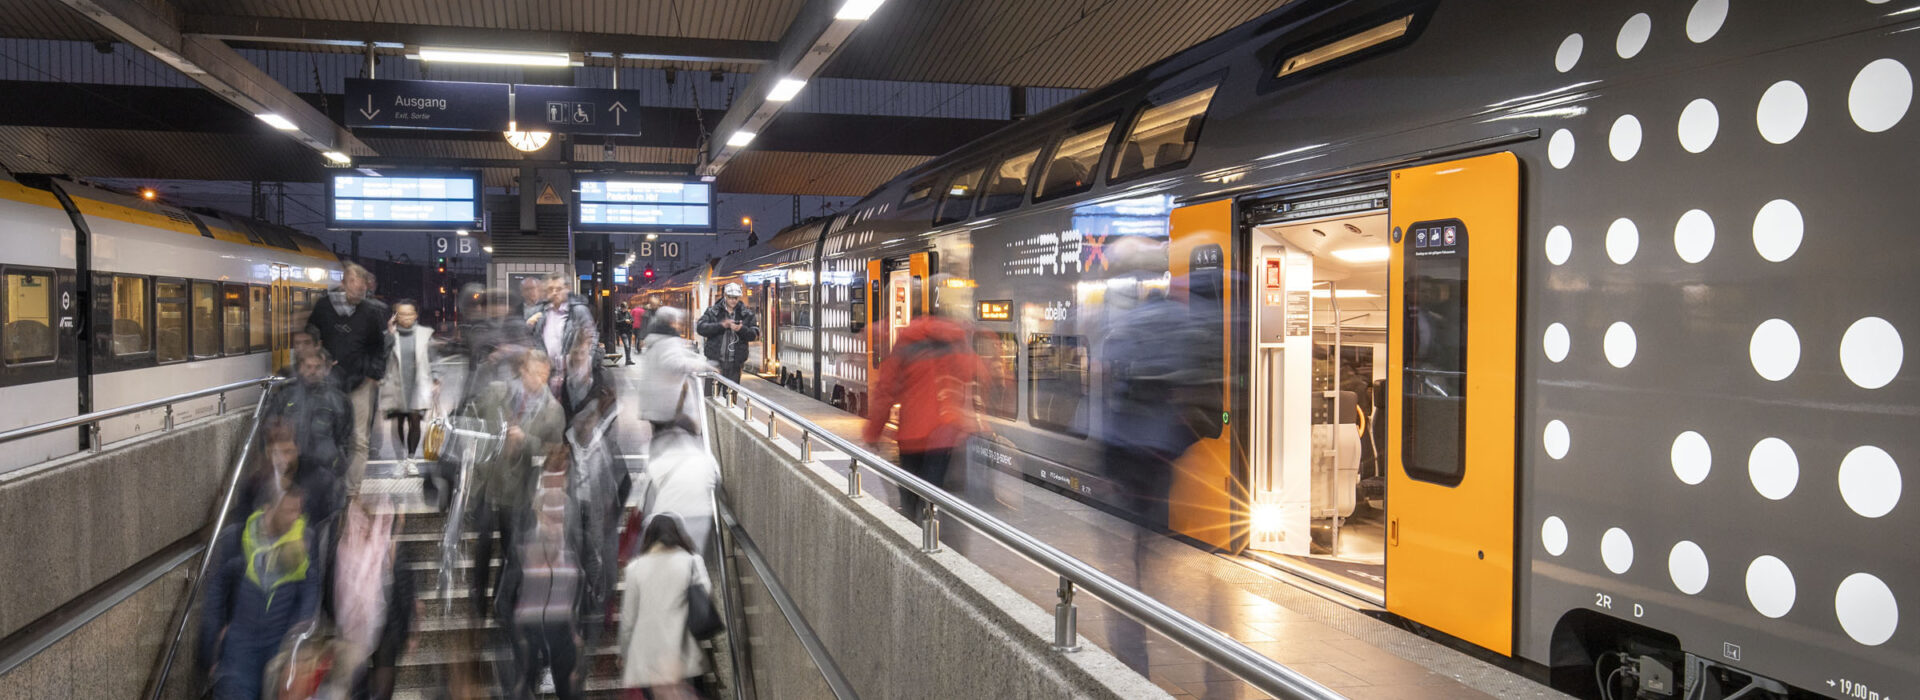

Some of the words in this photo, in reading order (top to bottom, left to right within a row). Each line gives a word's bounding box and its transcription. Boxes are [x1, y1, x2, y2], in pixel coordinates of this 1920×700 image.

[394, 95, 447, 110] Ausgang
[437, 237, 448, 254] 9
[460, 238, 472, 254] B
[641, 241, 652, 257] B
[660, 242, 679, 258] 10
[935, 286, 940, 308] 2
[1044, 301, 1067, 320] abellio
[1595, 592, 1612, 609] 2R
[1634, 603, 1644, 618] D
[1839, 678, 1867, 700] 19.00
[1868, 690, 1879, 700] m
